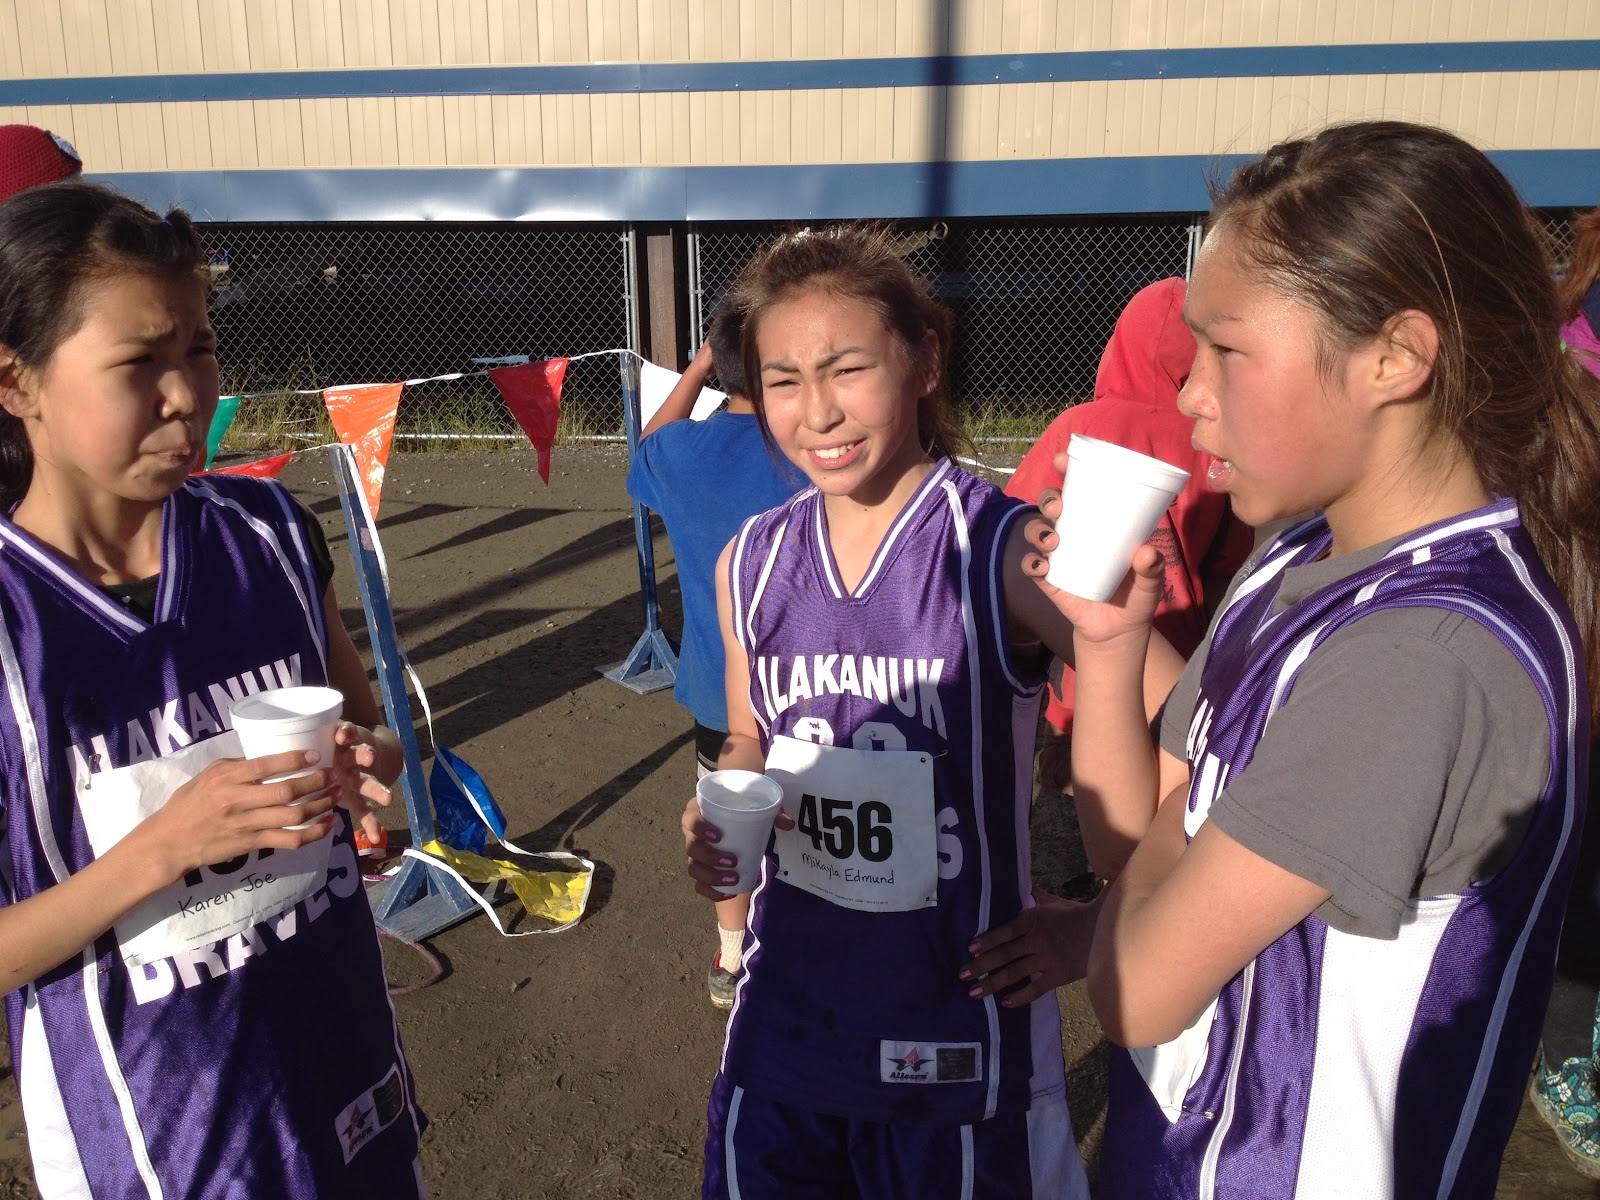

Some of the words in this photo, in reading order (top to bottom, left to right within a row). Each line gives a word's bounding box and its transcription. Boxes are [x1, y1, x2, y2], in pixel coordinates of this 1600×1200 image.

[797, 793, 893, 862] 456
[178, 891, 235, 918] Karen
[240, 872, 277, 892] Joe
[844, 867, 895, 885] Edmund
